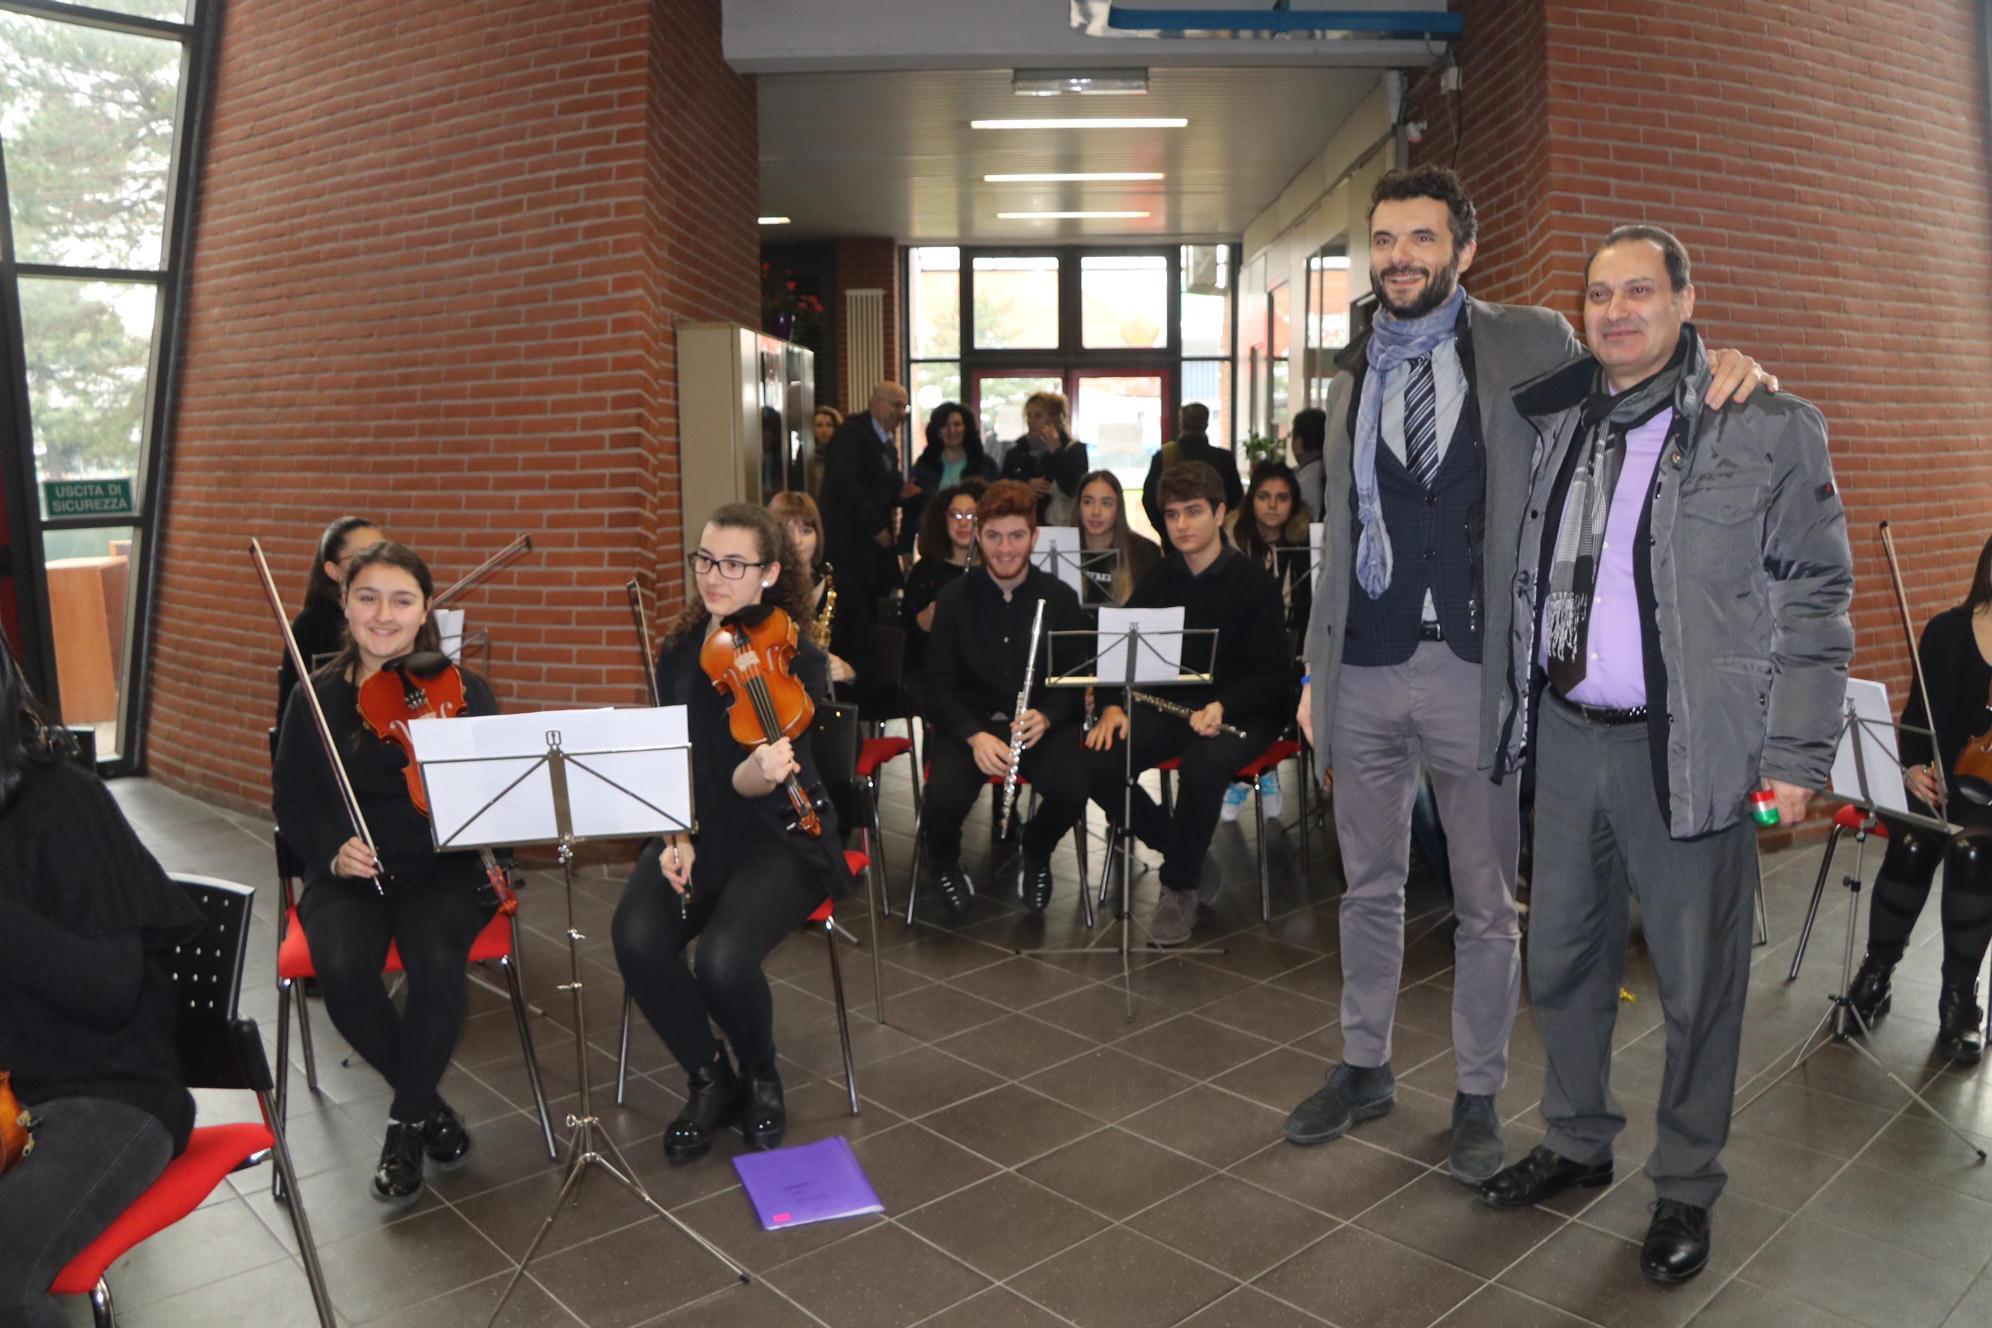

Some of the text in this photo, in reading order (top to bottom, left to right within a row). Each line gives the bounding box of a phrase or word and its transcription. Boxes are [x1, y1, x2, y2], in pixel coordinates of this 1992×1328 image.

[55, 484, 122, 497] USCITA DI
[52, 498, 128, 512] SICUREZZA
